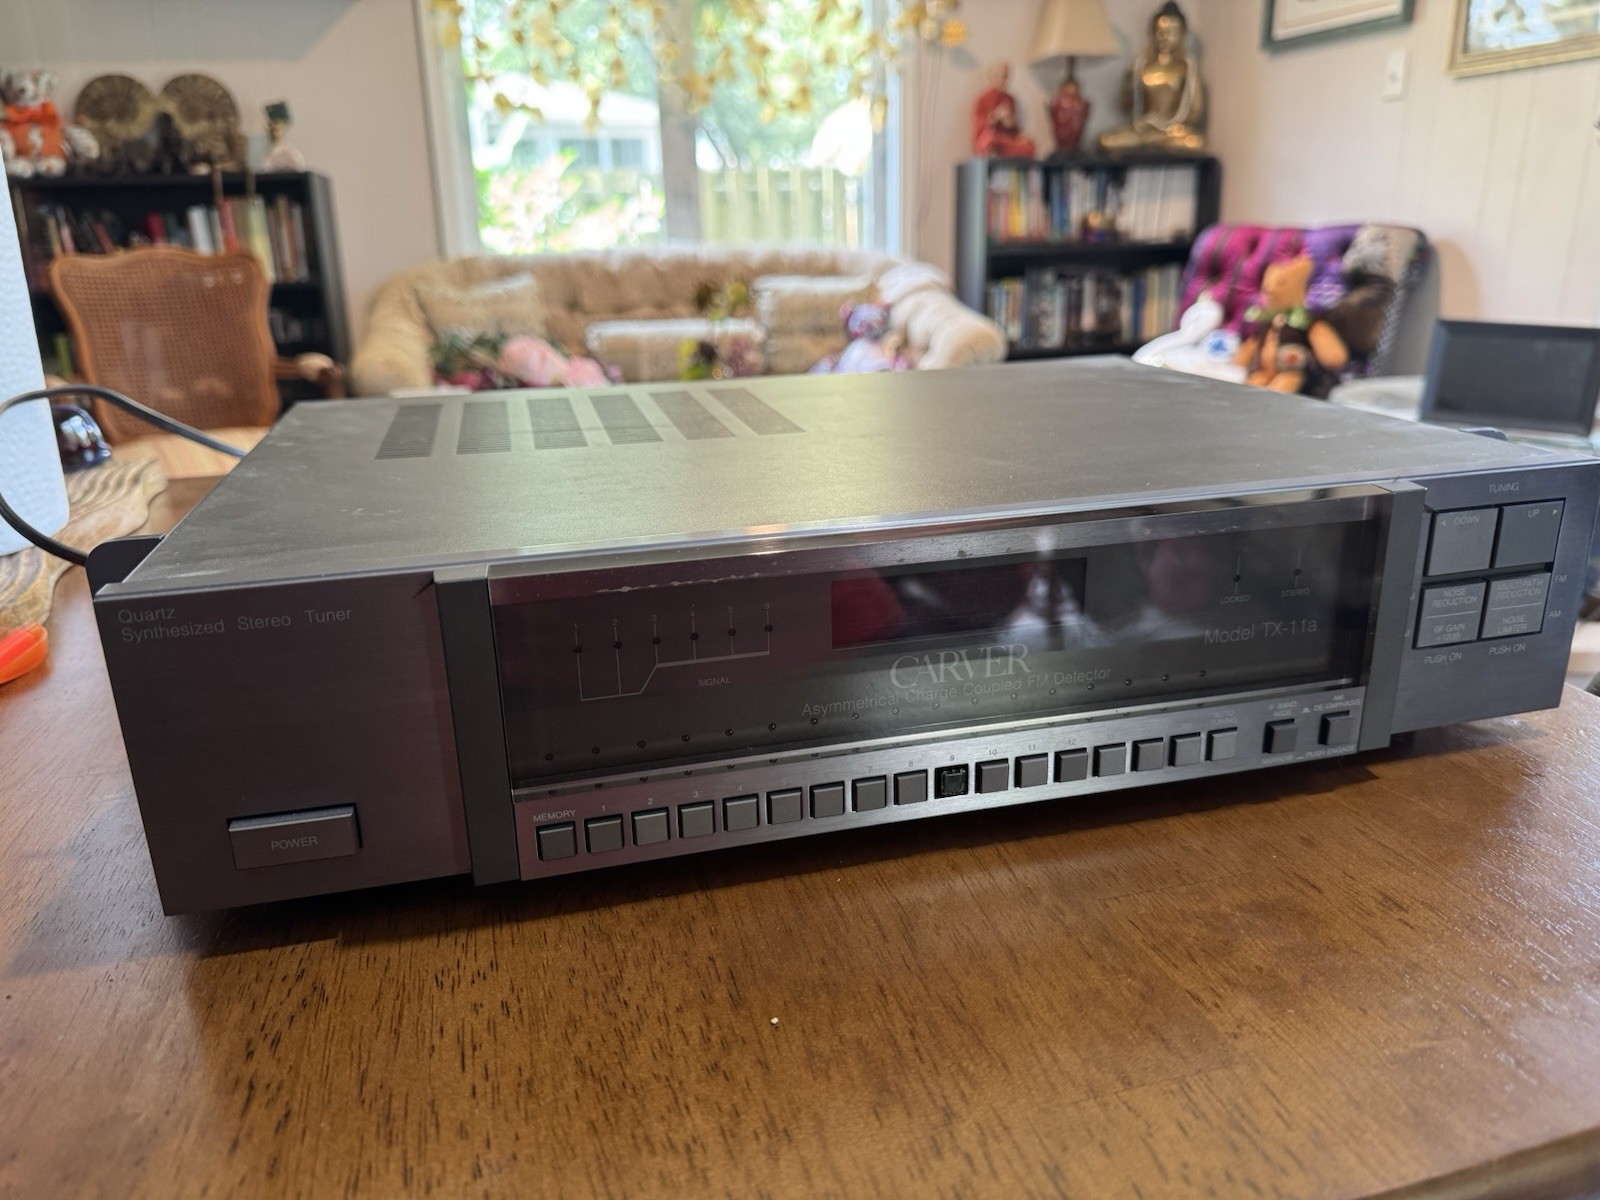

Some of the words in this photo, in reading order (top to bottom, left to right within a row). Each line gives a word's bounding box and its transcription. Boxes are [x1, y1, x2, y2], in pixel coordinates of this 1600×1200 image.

[1488, 481, 1520, 493] TUNING
[1527, 508, 1541, 518] UP
[1453, 514, 1481, 526] DOWN
[1554, 574, 1567, 584] FM
[1432, 595, 1478, 608] REDUCTION
[118, 607, 177, 624] Quartz
[1502, 614, 1526, 625] NOISE
[1549, 609, 1562, 619] AM
[121, 618, 226, 645] Synthesized
[237, 615, 292, 631] Stereo
[304, 608, 353, 624] Tuner
[1202, 622, 1255, 645] Model
[1261, 618, 1318, 639] TX-11a
[1433, 625, 1444, 635] RF
[1445, 623, 1466, 633] GAIN
[1488, 644, 1512, 655] PUSH
[1513, 642, 1527, 652] ON
[1424, 653, 1447, 664] PUSH
[1448, 651, 1462, 662] ON
[890, 643, 1032, 689] CARVER
[698, 676, 732, 687] SIGNAL
[801, 692, 899, 718] Asymmetrical
[904, 686, 957, 702] Charge
[963, 679, 1022, 697] Coupled
[1027, 672, 1049, 688] FM
[1054, 667, 1112, 685] Detector
[1276, 701, 1297, 710] BAND
[1273, 709, 1293, 718] WIDE
[1028, 743, 1037, 751] 11
[1067, 738, 1077, 746] 12
[988, 749, 998, 757] 10
[1305, 749, 1325, 759] PUSH
[533, 808, 577, 823] MEMORY
[270, 835, 319, 851] POWER
